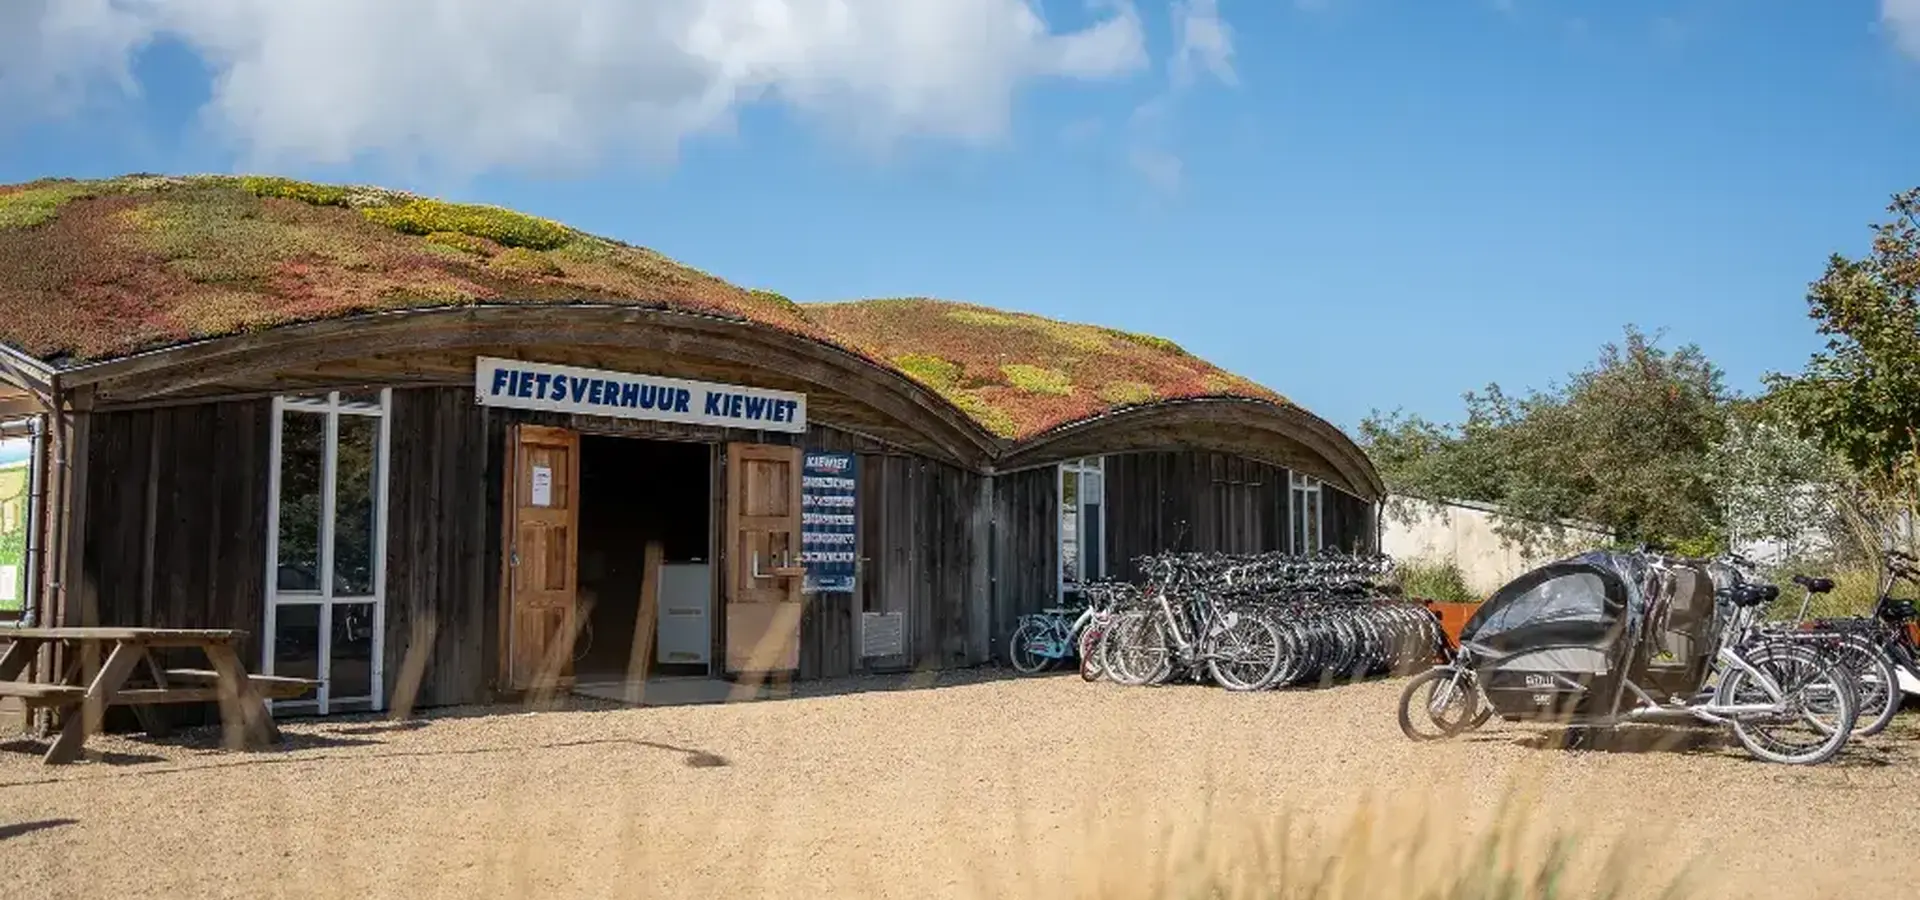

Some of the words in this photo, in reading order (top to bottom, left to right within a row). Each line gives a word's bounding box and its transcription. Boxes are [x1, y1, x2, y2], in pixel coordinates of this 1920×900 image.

[491, 368, 691, 413] FIETSVERHUUR
[704, 391, 798, 423] KIEWIET
[806, 456, 848, 469] KIEWIET
